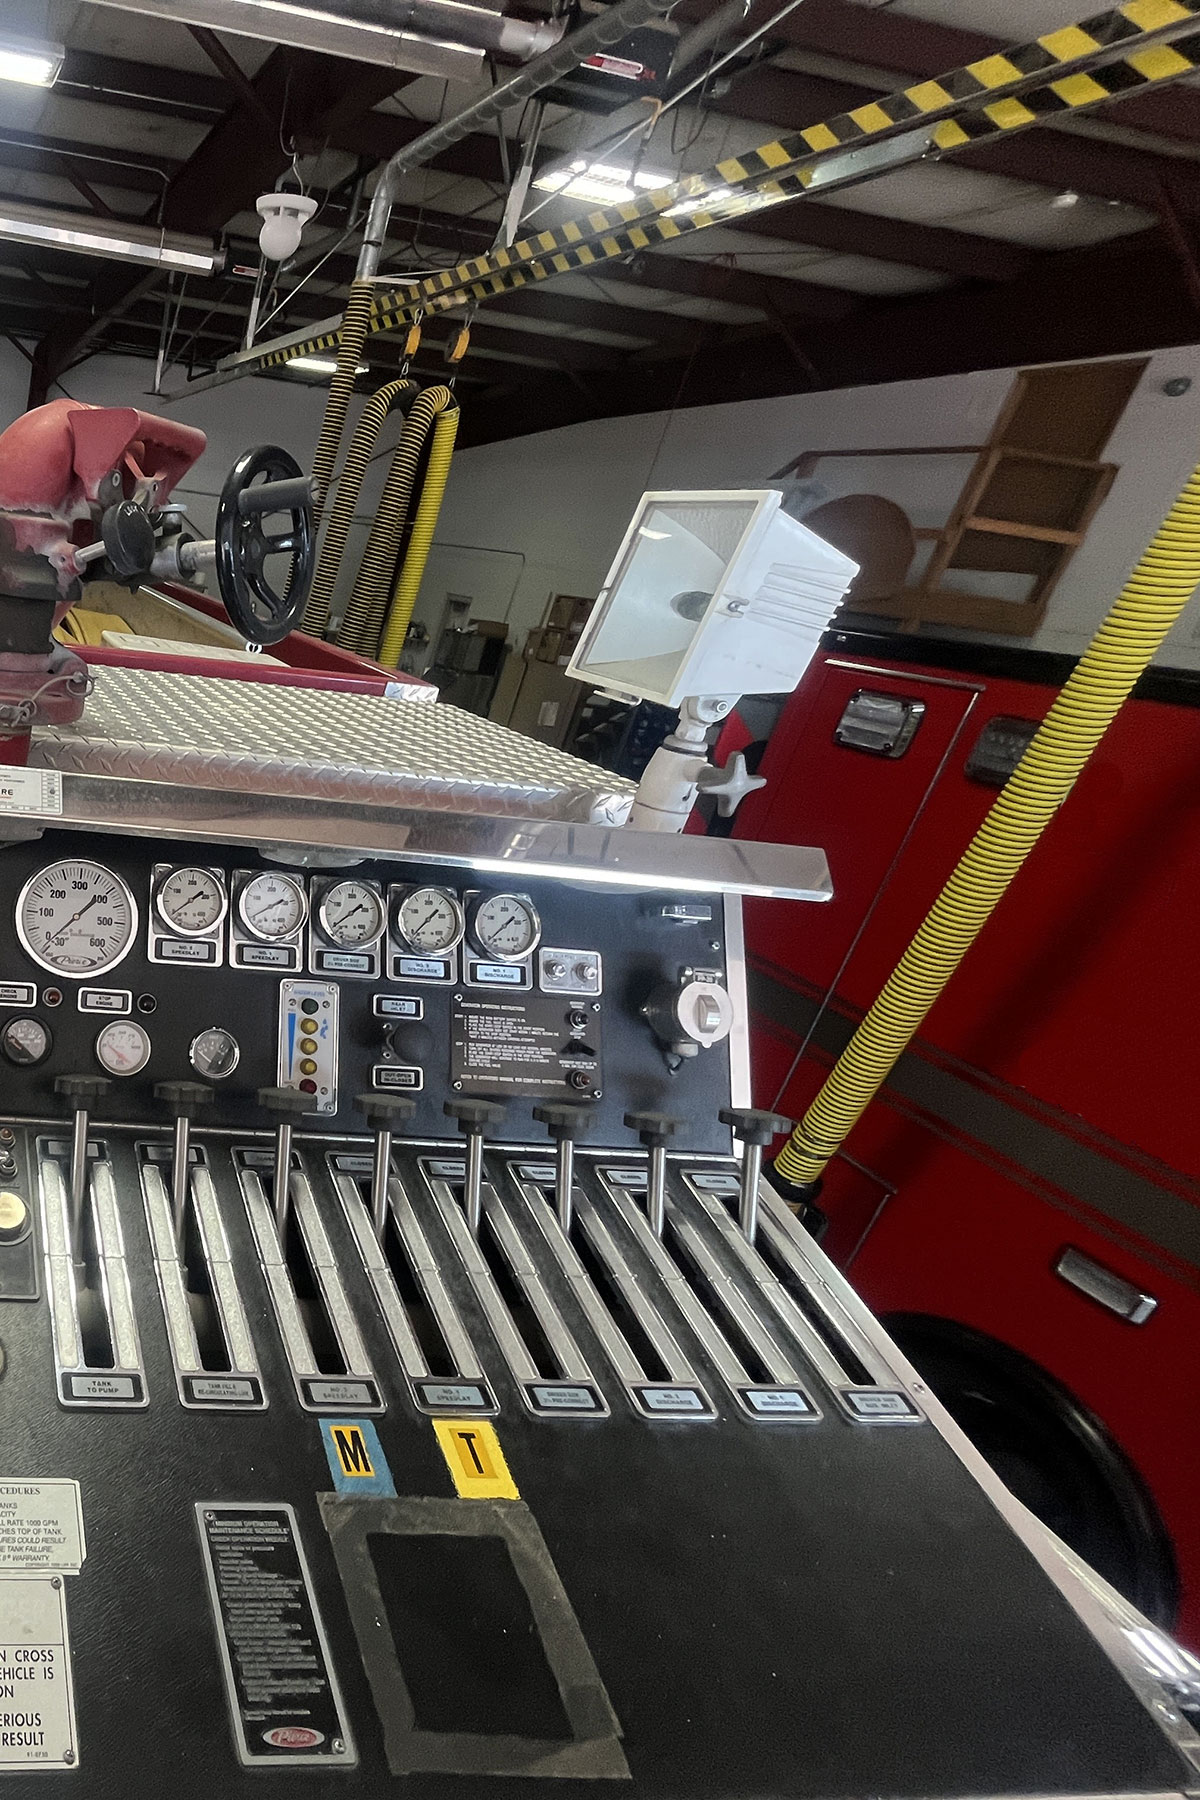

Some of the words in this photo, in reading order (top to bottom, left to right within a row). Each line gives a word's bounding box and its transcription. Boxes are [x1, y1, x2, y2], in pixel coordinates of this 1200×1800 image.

[71, 880, 88, 891] 300
[50, 889, 66, 900] 200
[92, 894, 108, 905] 400
[39, 907, 54, 918] 100
[97, 916, 113, 927] 500
[90, 937, 106, 948] 600
[60, 956, 88, 966] Pierce
[334, 1429, 372, 1472] M
[457, 1432, 484, 1474] T
[26, 1519, 41, 1527] 1000
[42, 1519, 59, 1527] GPM
[14, 1649, 54, 1662] CROSS
[43, 1667, 54, 1680] IS
[2, 1732, 45, 1746] RESULT
